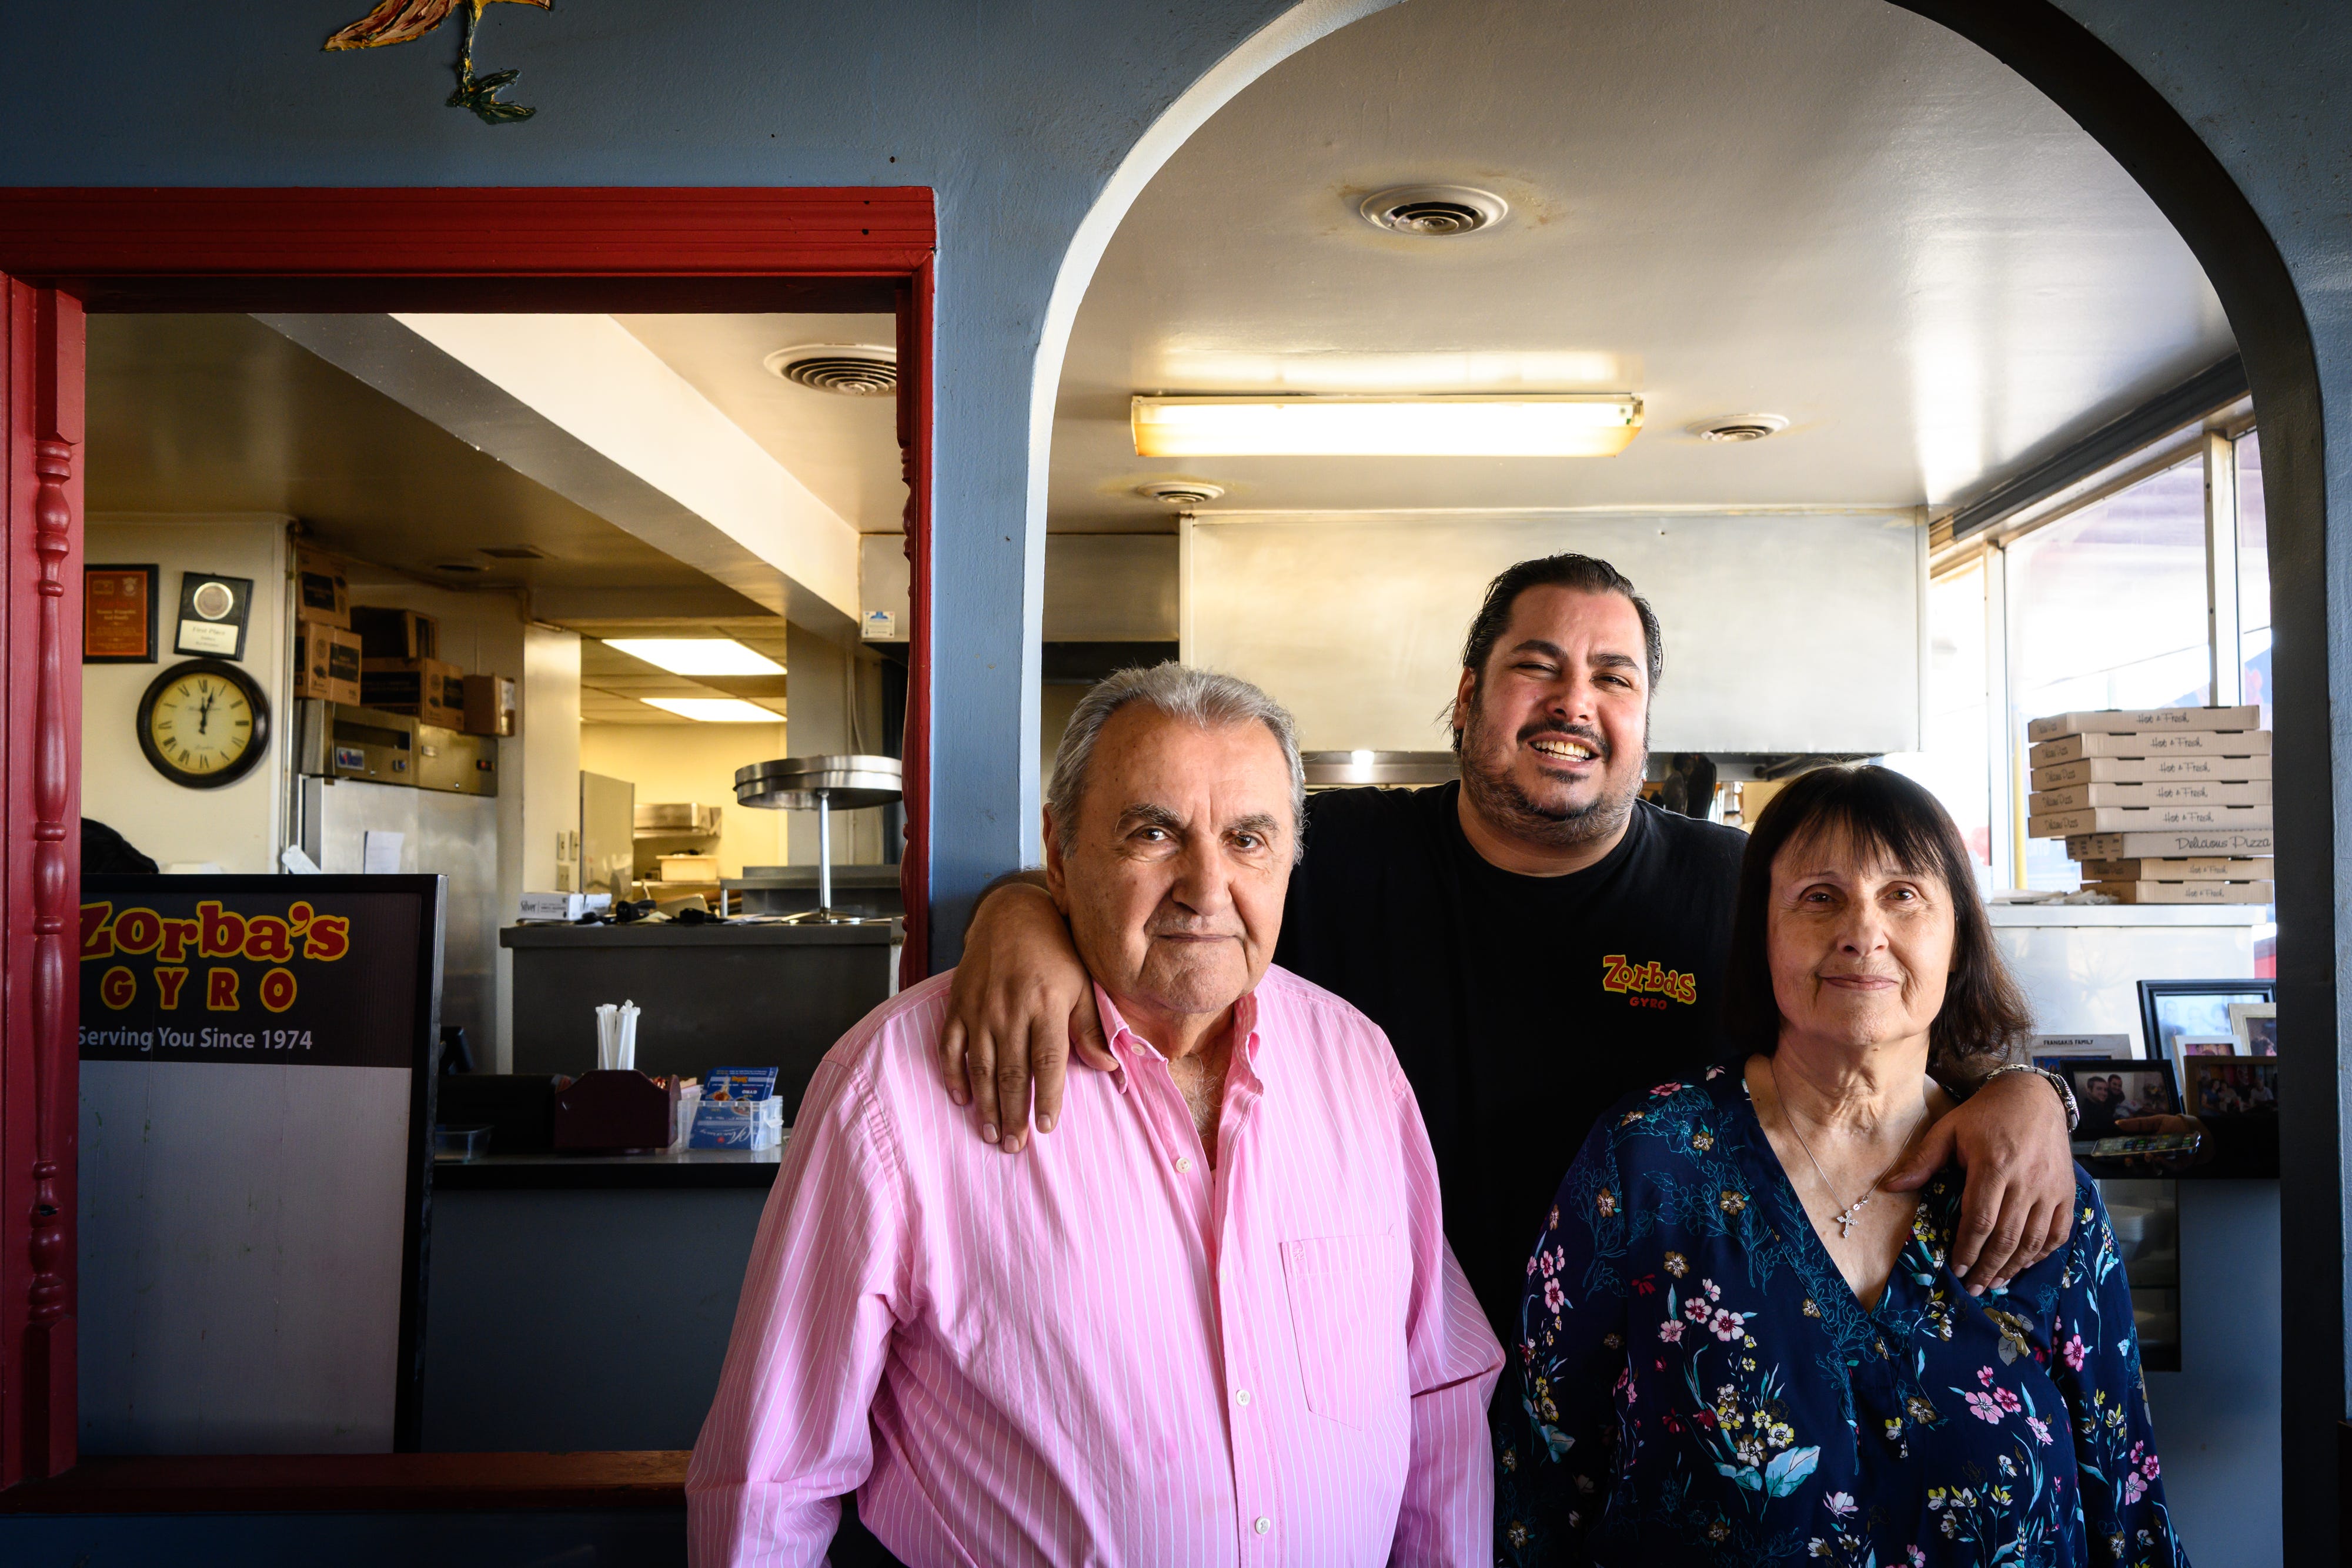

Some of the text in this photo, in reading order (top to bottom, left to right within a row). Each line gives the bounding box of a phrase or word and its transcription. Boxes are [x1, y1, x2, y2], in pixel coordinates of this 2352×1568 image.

[2175, 835, 2271, 850] Delicious Pizza
[80, 901, 350, 964] Zorba's
[101, 965, 298, 1013] GYRO
[1629, 997, 1668, 1010] GYRO
[79, 1026, 312, 1051] Serving You Since 1974
